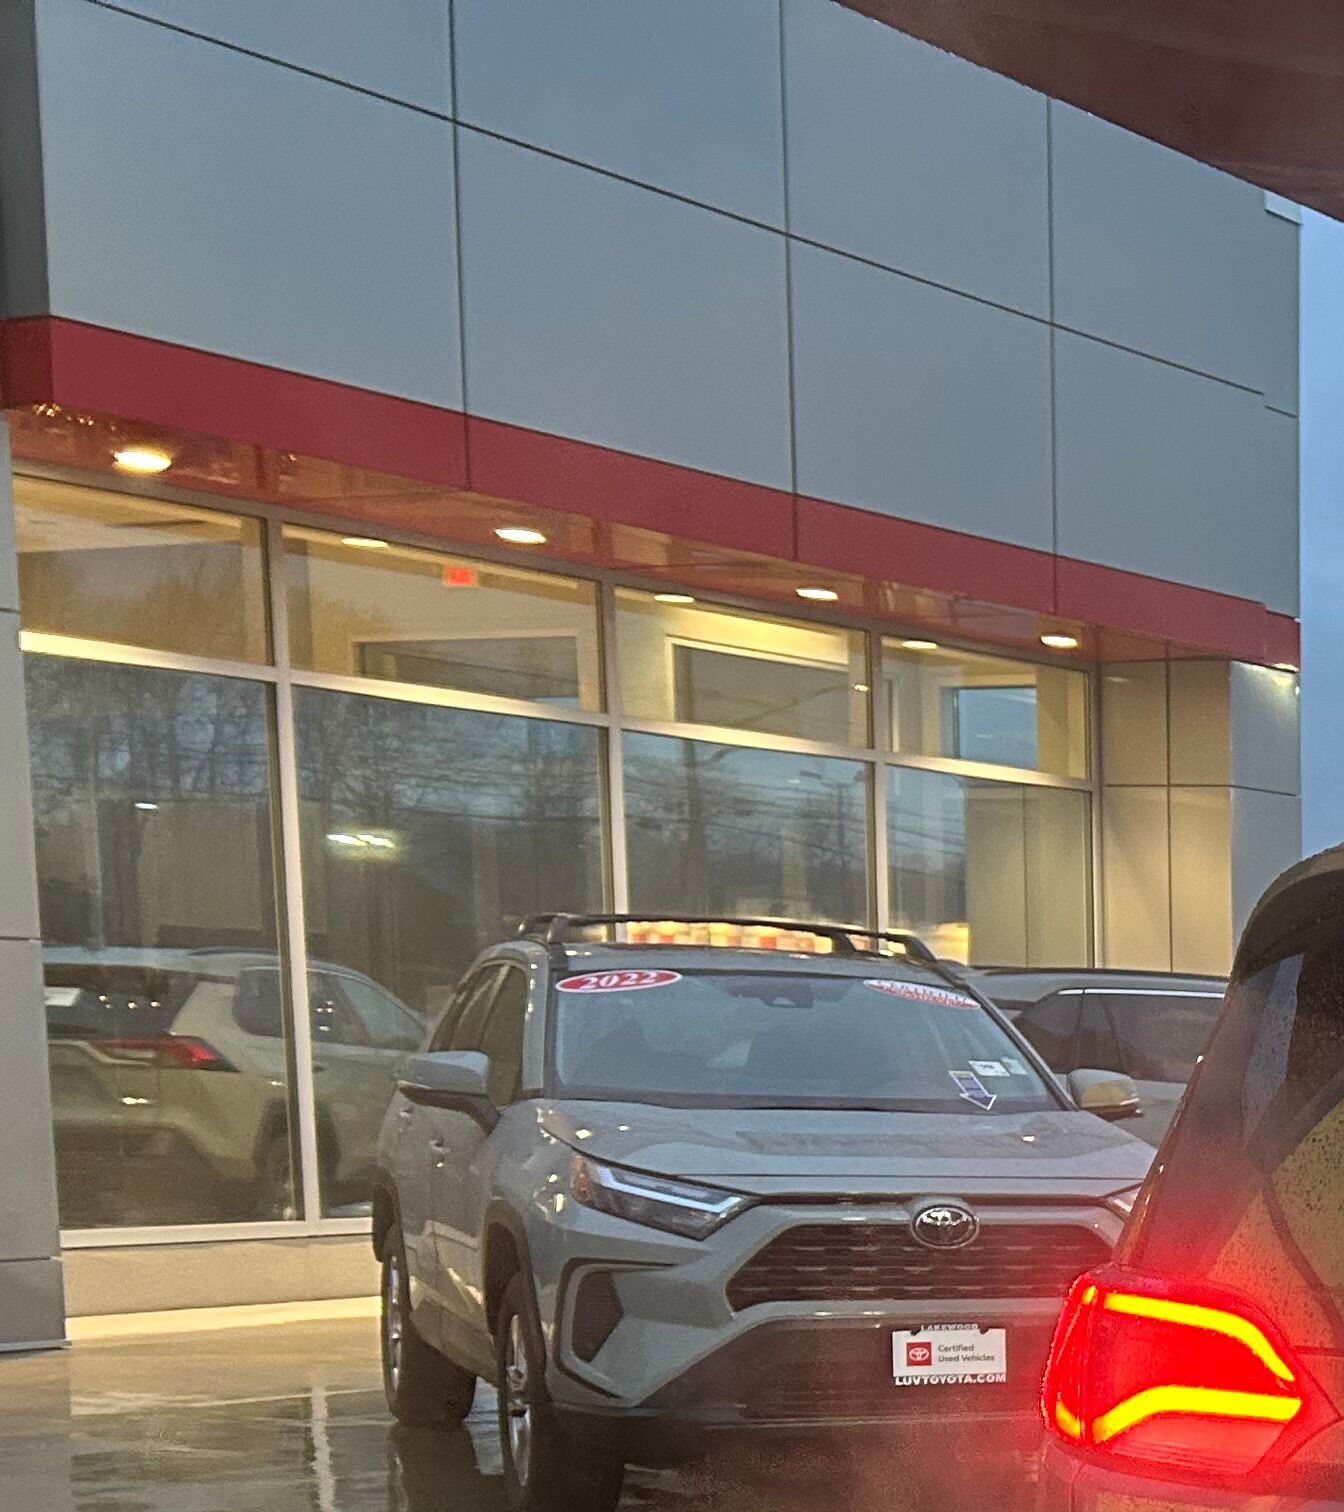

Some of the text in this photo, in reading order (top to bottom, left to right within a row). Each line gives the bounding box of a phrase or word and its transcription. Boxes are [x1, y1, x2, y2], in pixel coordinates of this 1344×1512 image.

[580, 972, 658, 989] 2022
[938, 1344, 974, 1353] Certified
[895, 1373, 1006, 1386] LUVTOYOTA.COM
